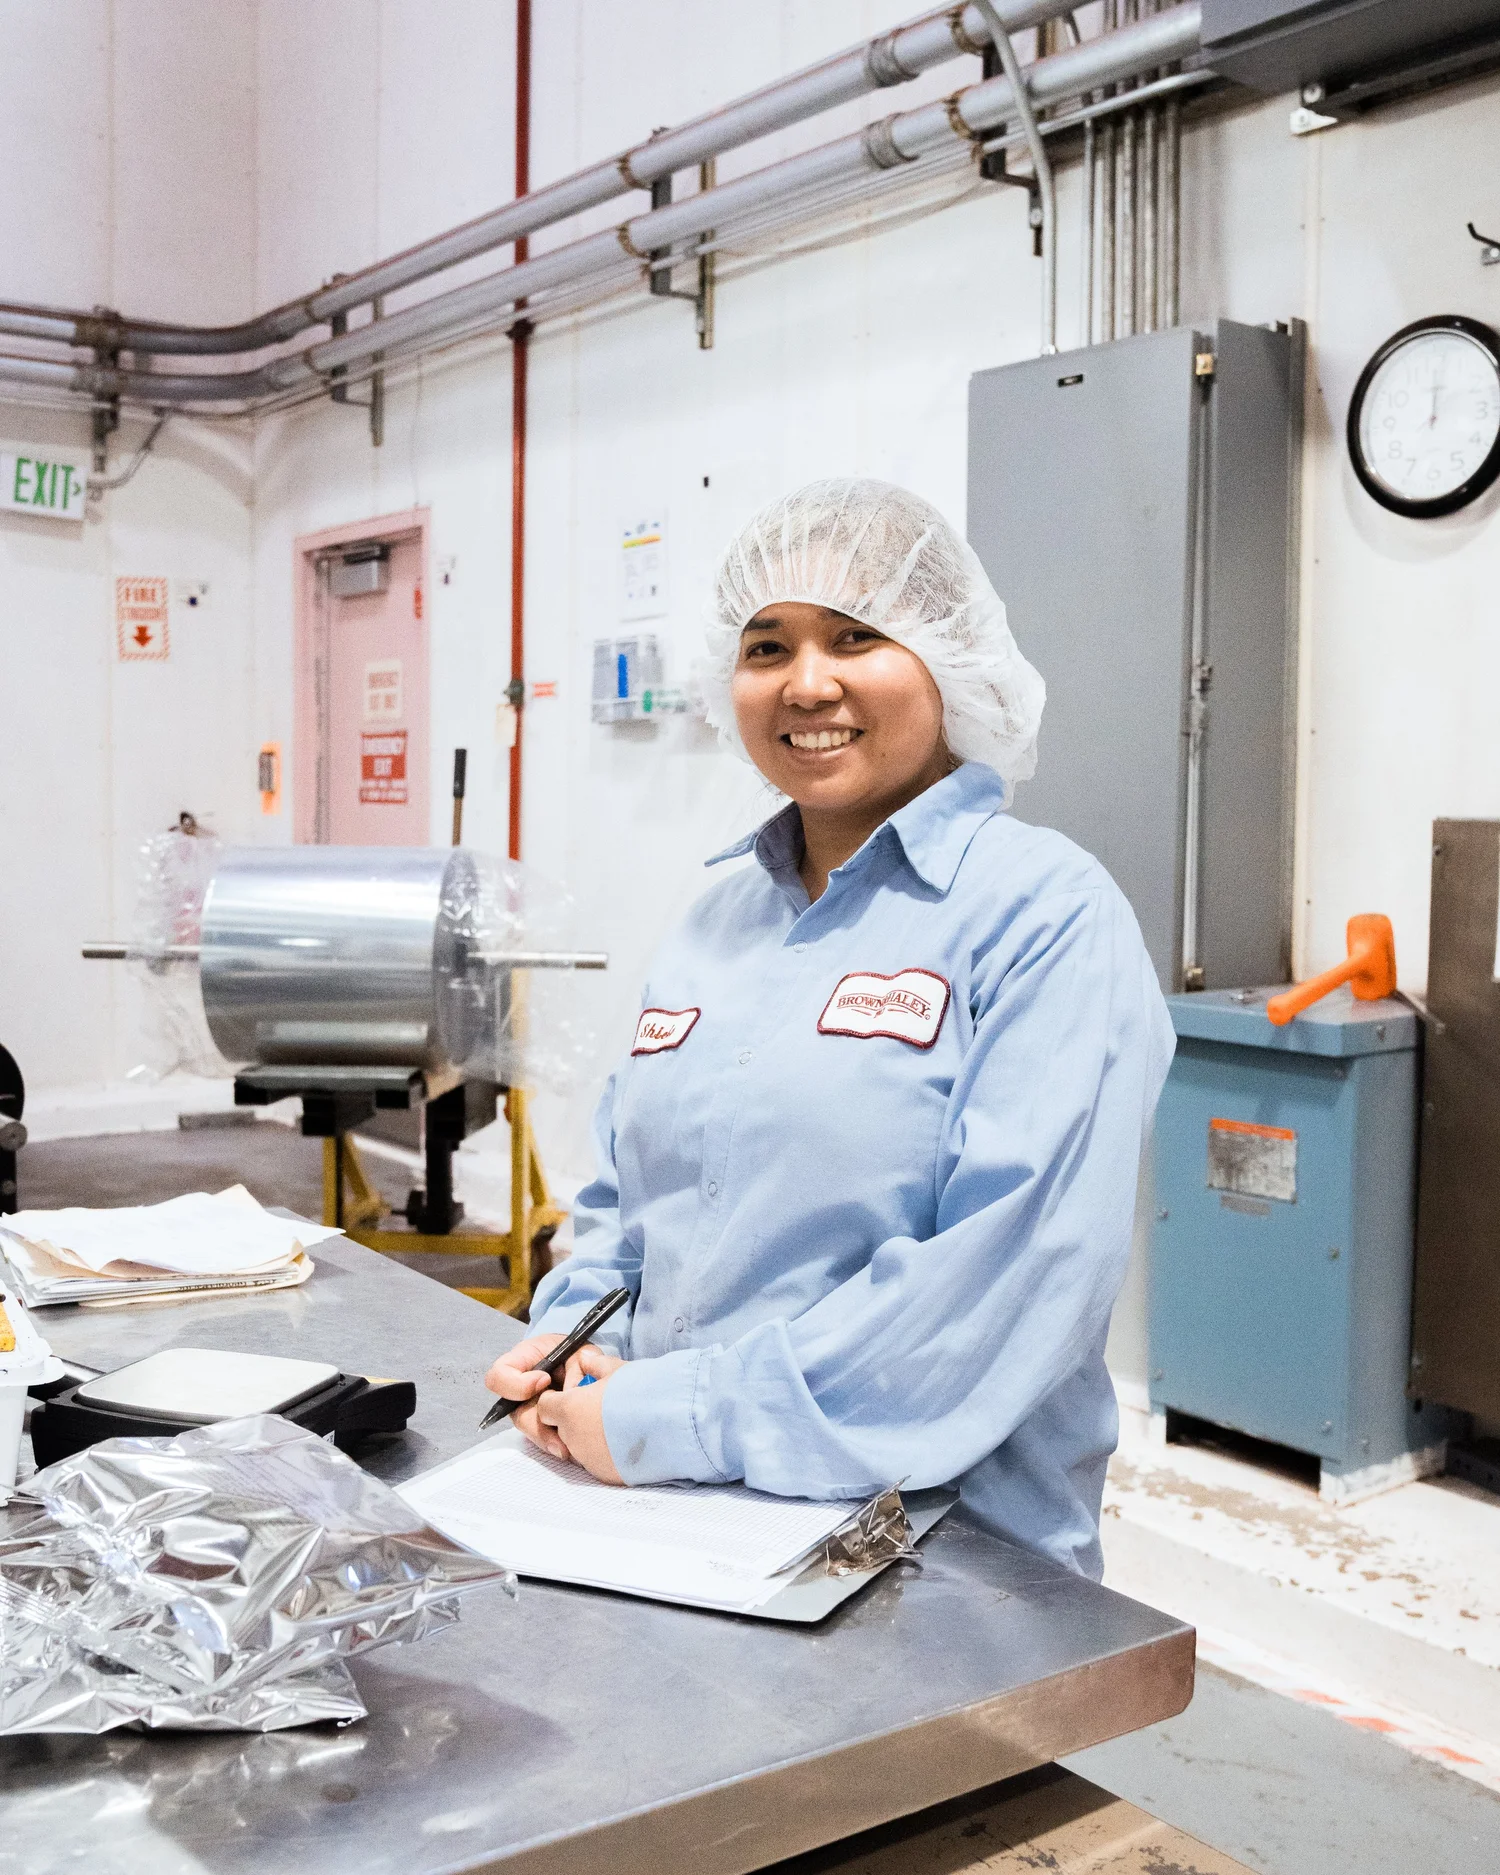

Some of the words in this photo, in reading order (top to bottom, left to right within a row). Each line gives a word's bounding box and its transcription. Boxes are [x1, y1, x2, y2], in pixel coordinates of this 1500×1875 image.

[1469, 375, 1483, 393] 2
[1388, 390, 1409, 408] 10
[1476, 401, 1488, 420] 3
[1383, 416, 1396, 431] 9
[1469, 431, 1481, 446] 4
[1388, 441, 1402, 459] 8
[1405, 458, 1416, 476] 7
[1450, 451, 1465, 470] 5
[1427, 464, 1441, 480] 6
[14, 457, 75, 510] EXIT
[837, 996, 882, 1008] BROWN
